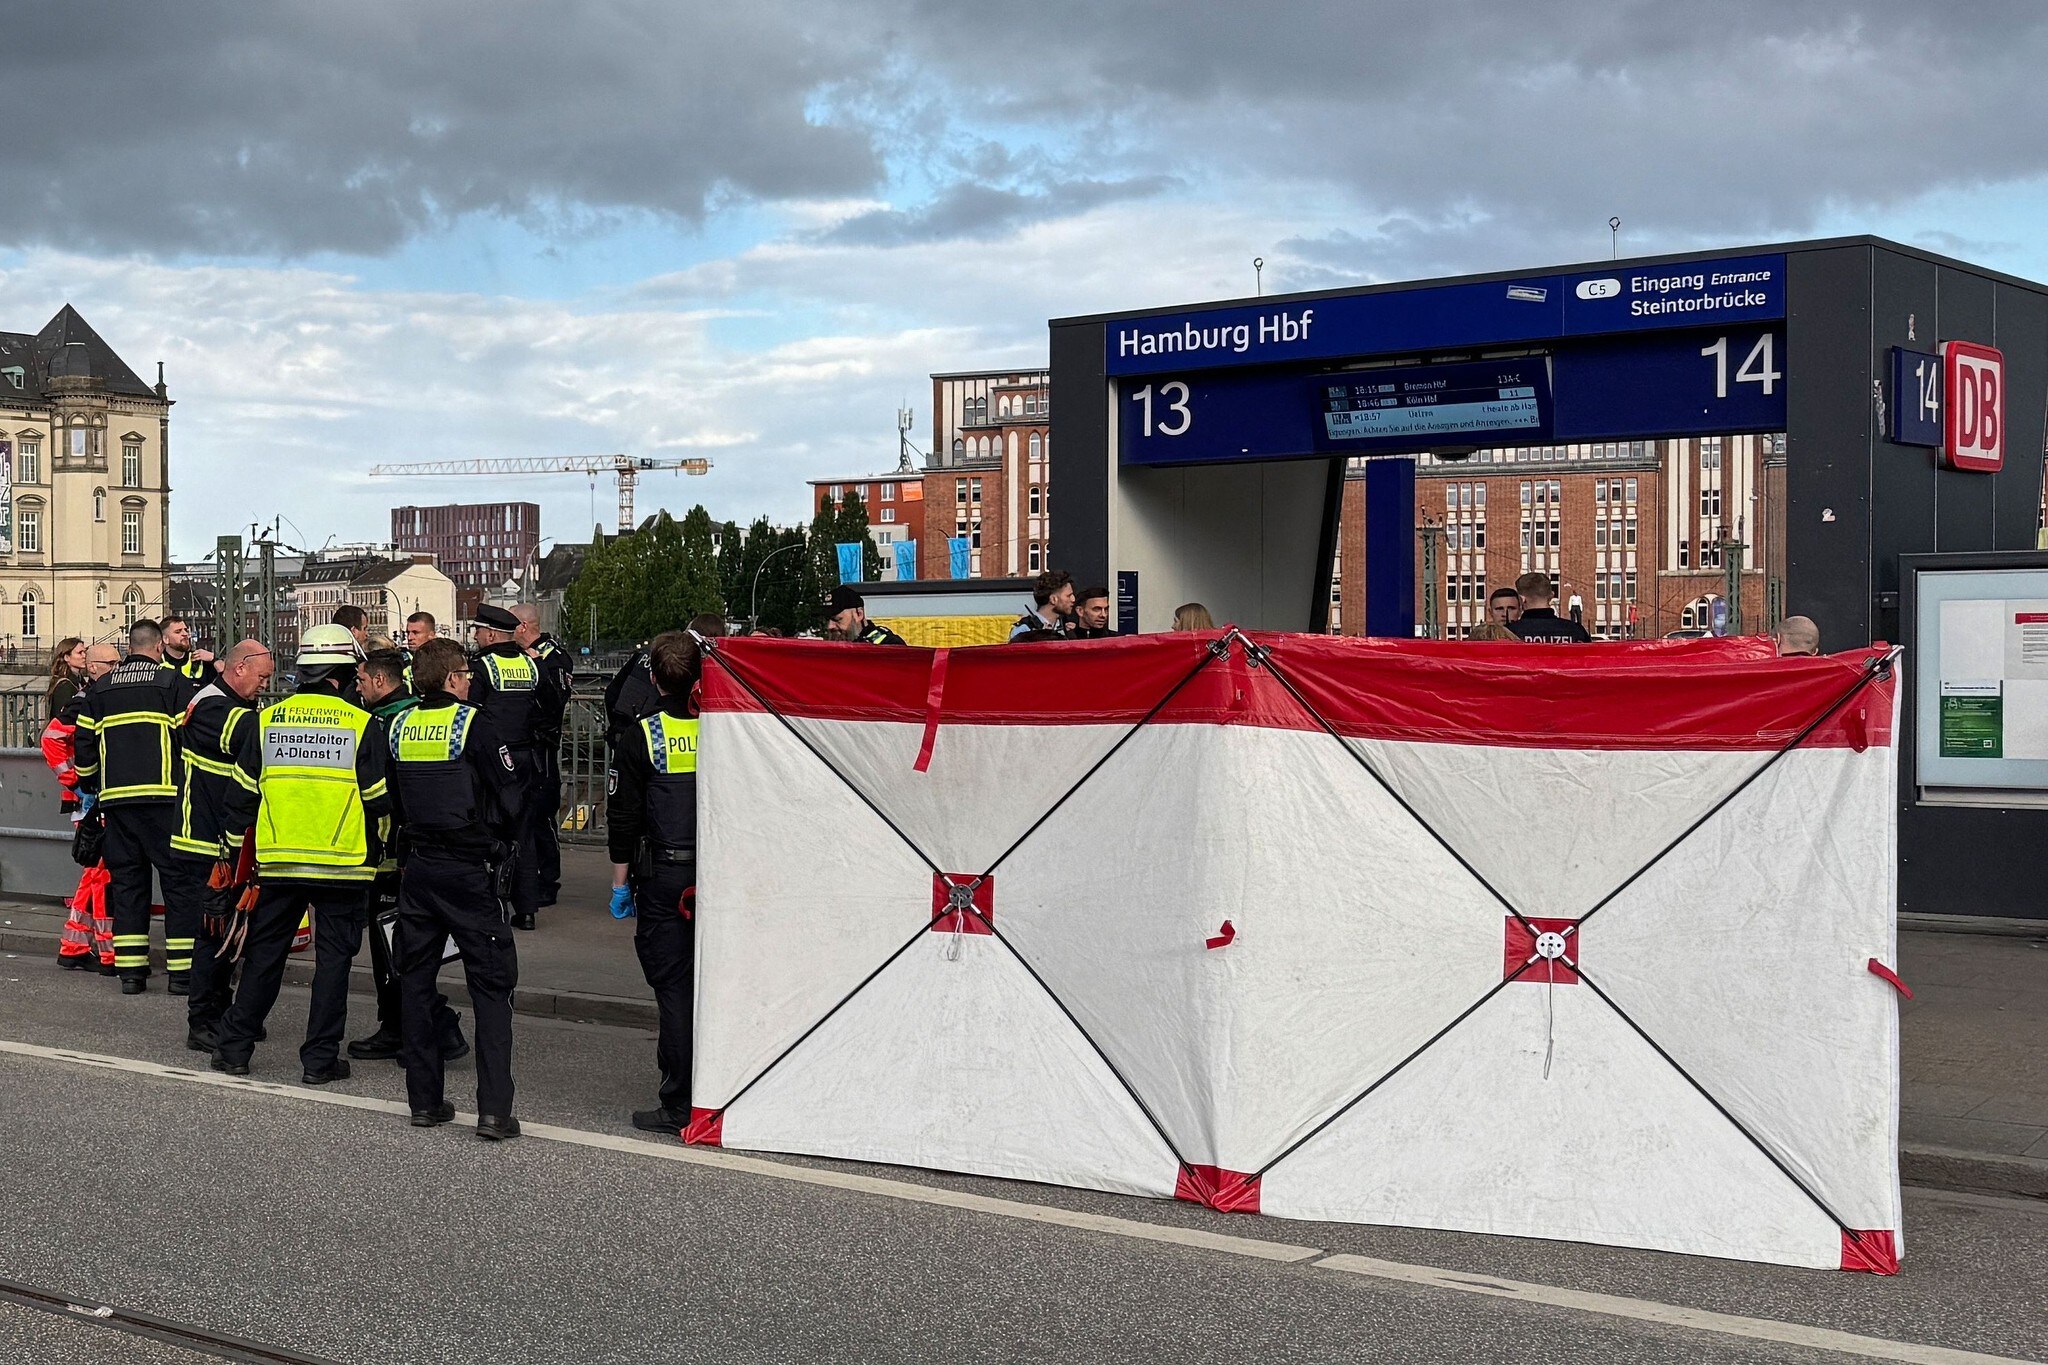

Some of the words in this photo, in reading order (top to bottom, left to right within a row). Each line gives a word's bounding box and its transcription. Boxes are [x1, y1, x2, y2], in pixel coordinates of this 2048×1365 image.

[1588, 283, 1606, 295] C5
[1631, 275, 1704, 293] Eingang
[1711, 271, 1771, 286] Entrance
[1631, 290, 1766, 316] Steintorbrücke
[1120, 322, 1249, 357] Hamburg
[1259, 309, 1314, 344] Hbf
[1701, 333, 1781, 398] 14
[1916, 360, 1939, 423] 14
[1132, 381, 1192, 437] 13
[1960, 364, 1998, 450] DB
[1525, 636, 1573, 644] POLIZEI
[111, 671, 155, 685] HAMBURG
[502, 668, 529, 678] POLIZEI
[288, 715, 340, 725] HAMBURG
[289, 706, 354, 719] FEUERWEHR
[269, 732, 349, 746] Einsatzleiter
[402, 725, 448, 741] POLIZEI
[275, 747, 330, 760] A-Dienst
[335, 749, 341, 760] 1
